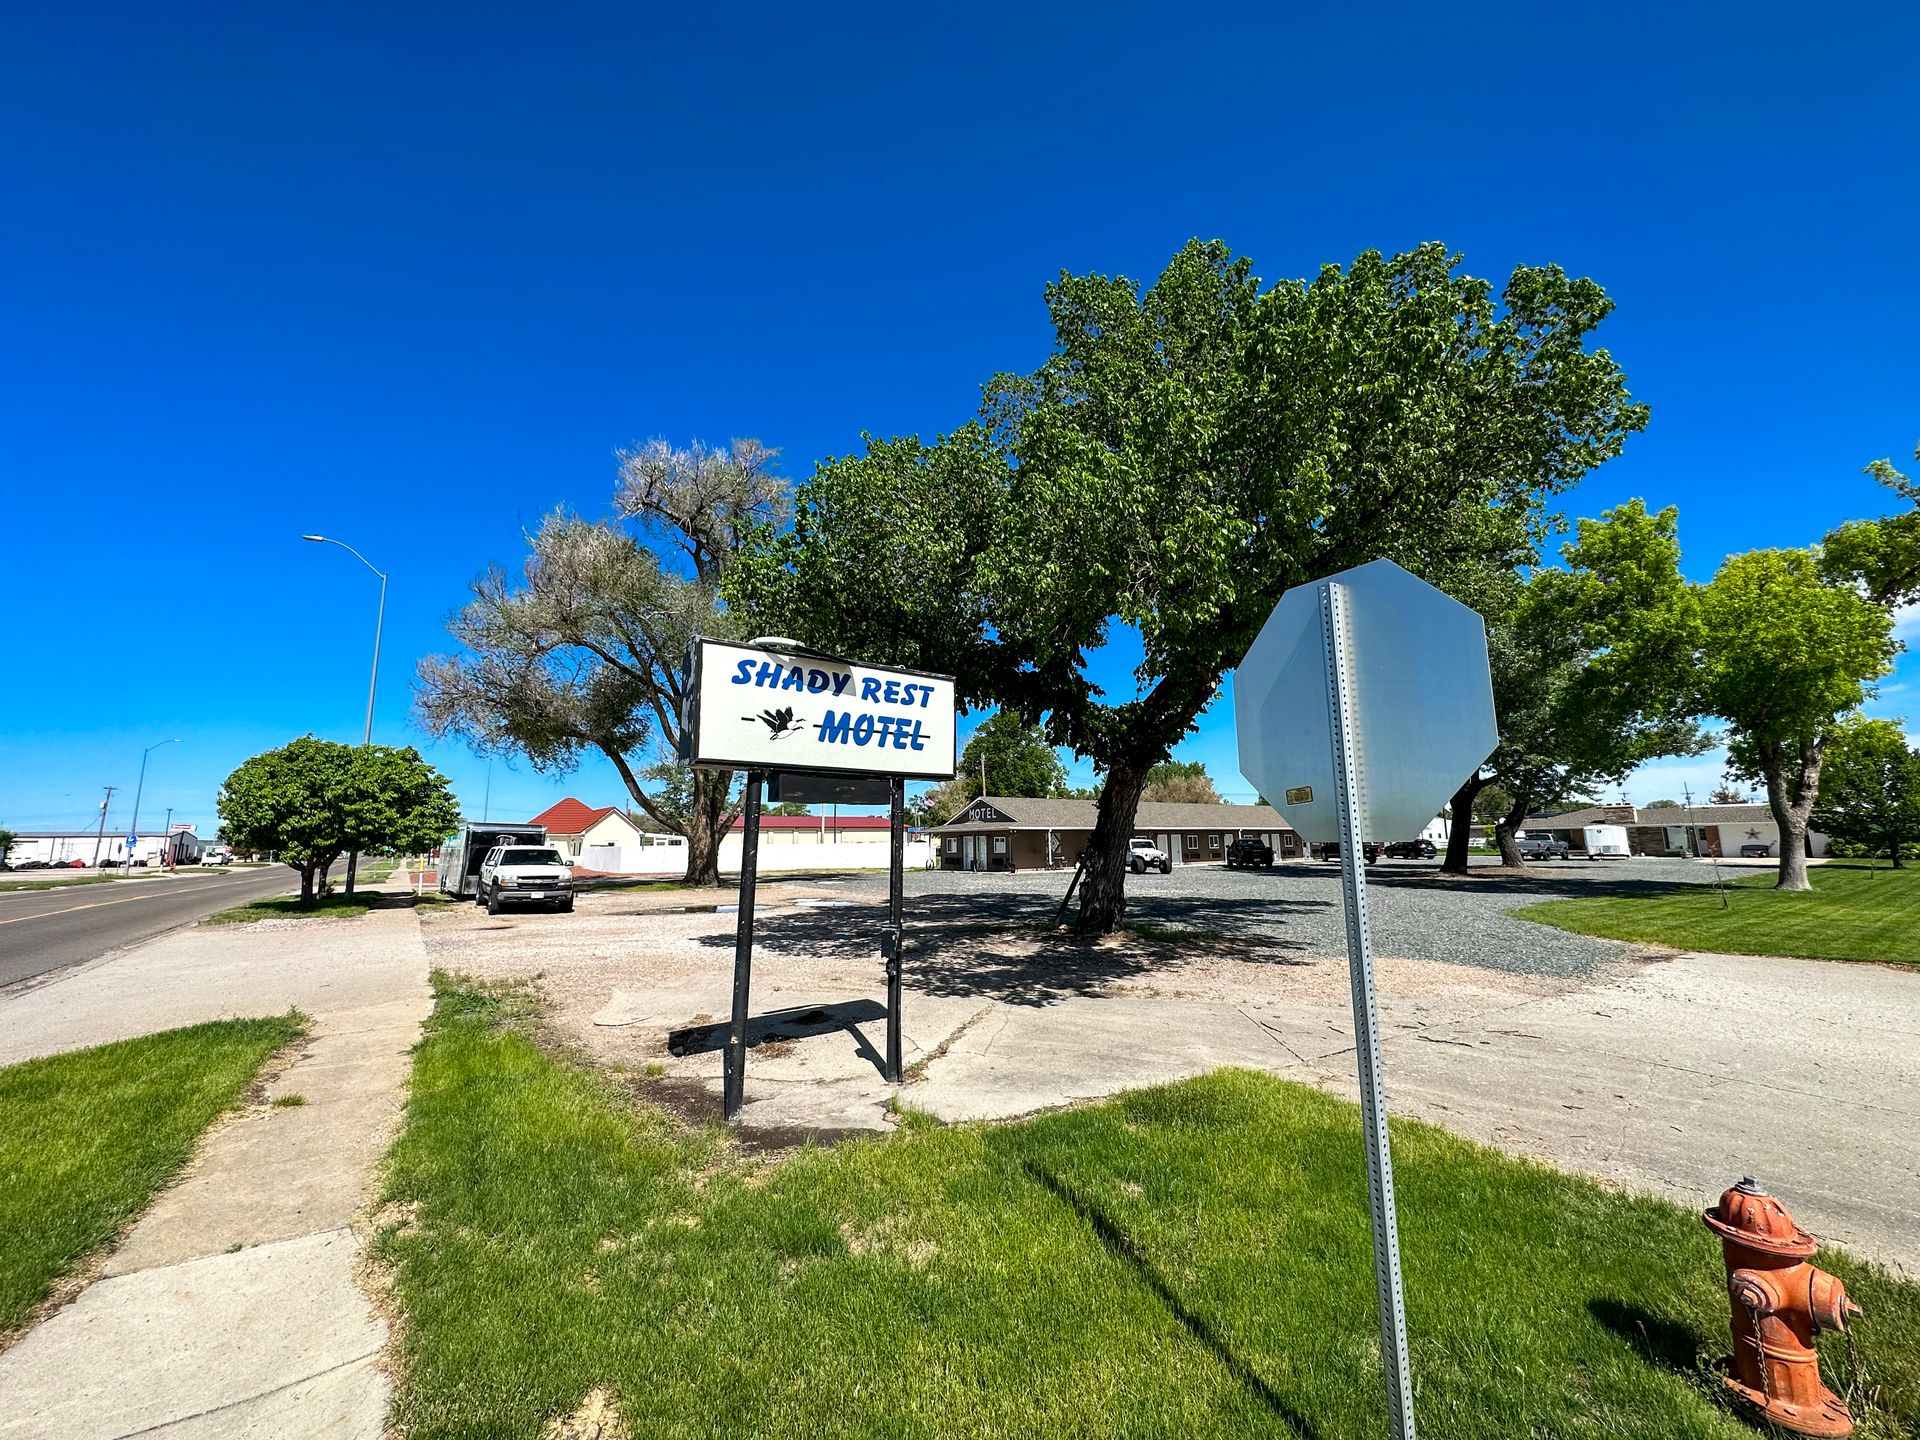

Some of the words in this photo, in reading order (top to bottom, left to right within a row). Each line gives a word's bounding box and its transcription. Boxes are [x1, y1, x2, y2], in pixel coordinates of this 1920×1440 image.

[731, 659, 851, 697] SHADY
[861, 677, 935, 708] REST
[818, 709, 925, 751] MOTEL
[968, 808, 997, 820] MOTEL
